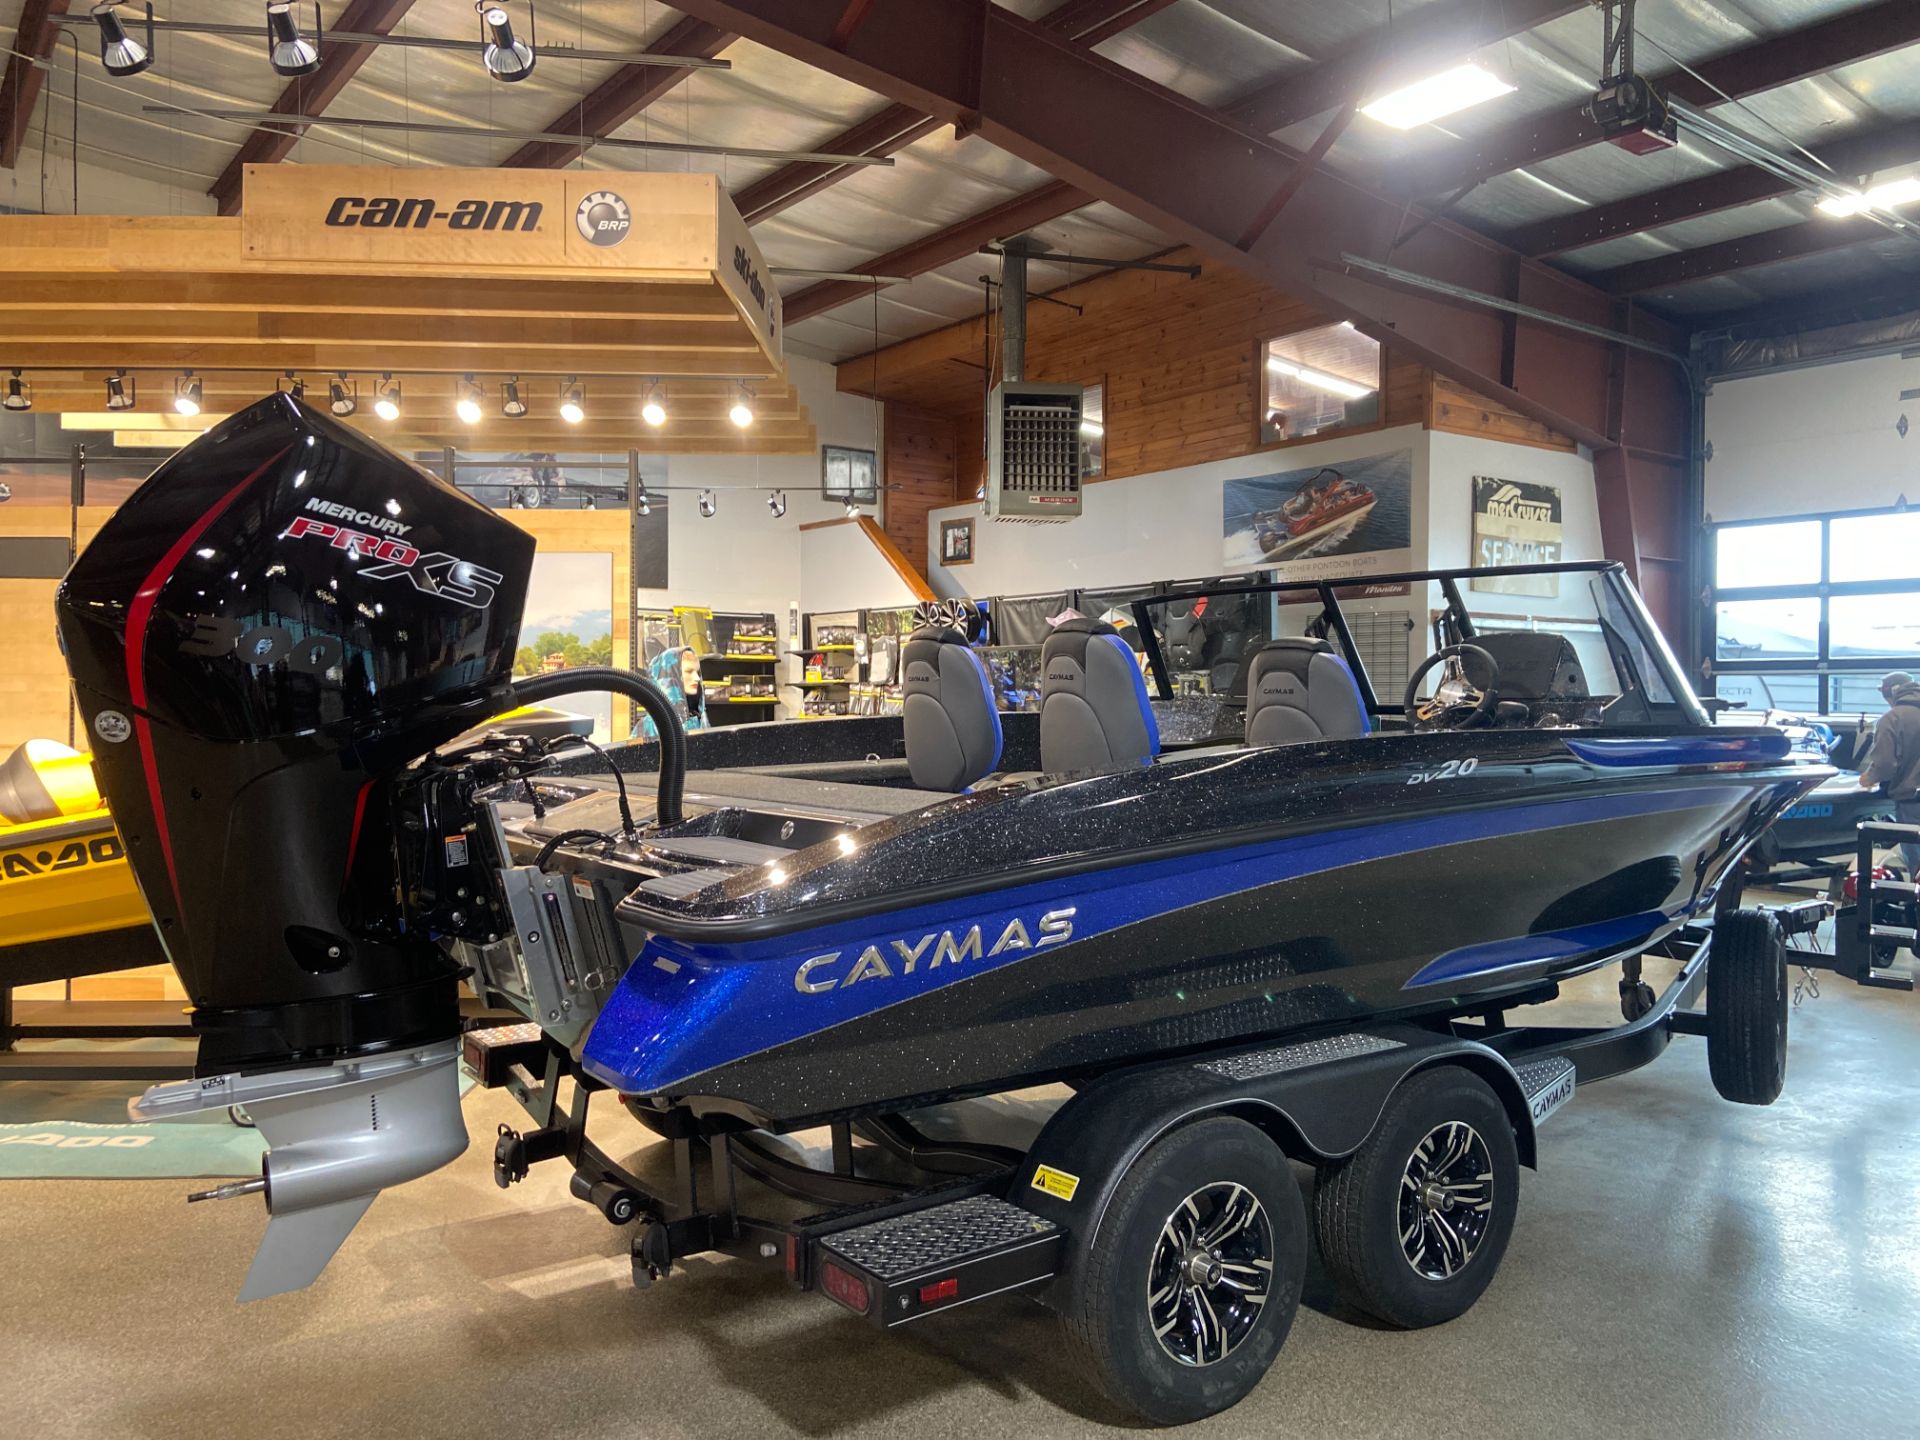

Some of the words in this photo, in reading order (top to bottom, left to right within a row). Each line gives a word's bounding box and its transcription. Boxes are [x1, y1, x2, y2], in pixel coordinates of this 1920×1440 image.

[325, 197, 543, 231] can-am
[597, 220, 629, 231] BRP
[304, 497, 412, 537] MERCURY
[1312, 560, 1351, 571] PONTOON
[1353, 556, 1378, 566] BOATS
[178, 613, 343, 674] 300
[1049, 673, 1074, 681] CAYMAS
[794, 907, 1077, 994] CAYMAS
[1533, 1079, 1571, 1119] CAYMAS
